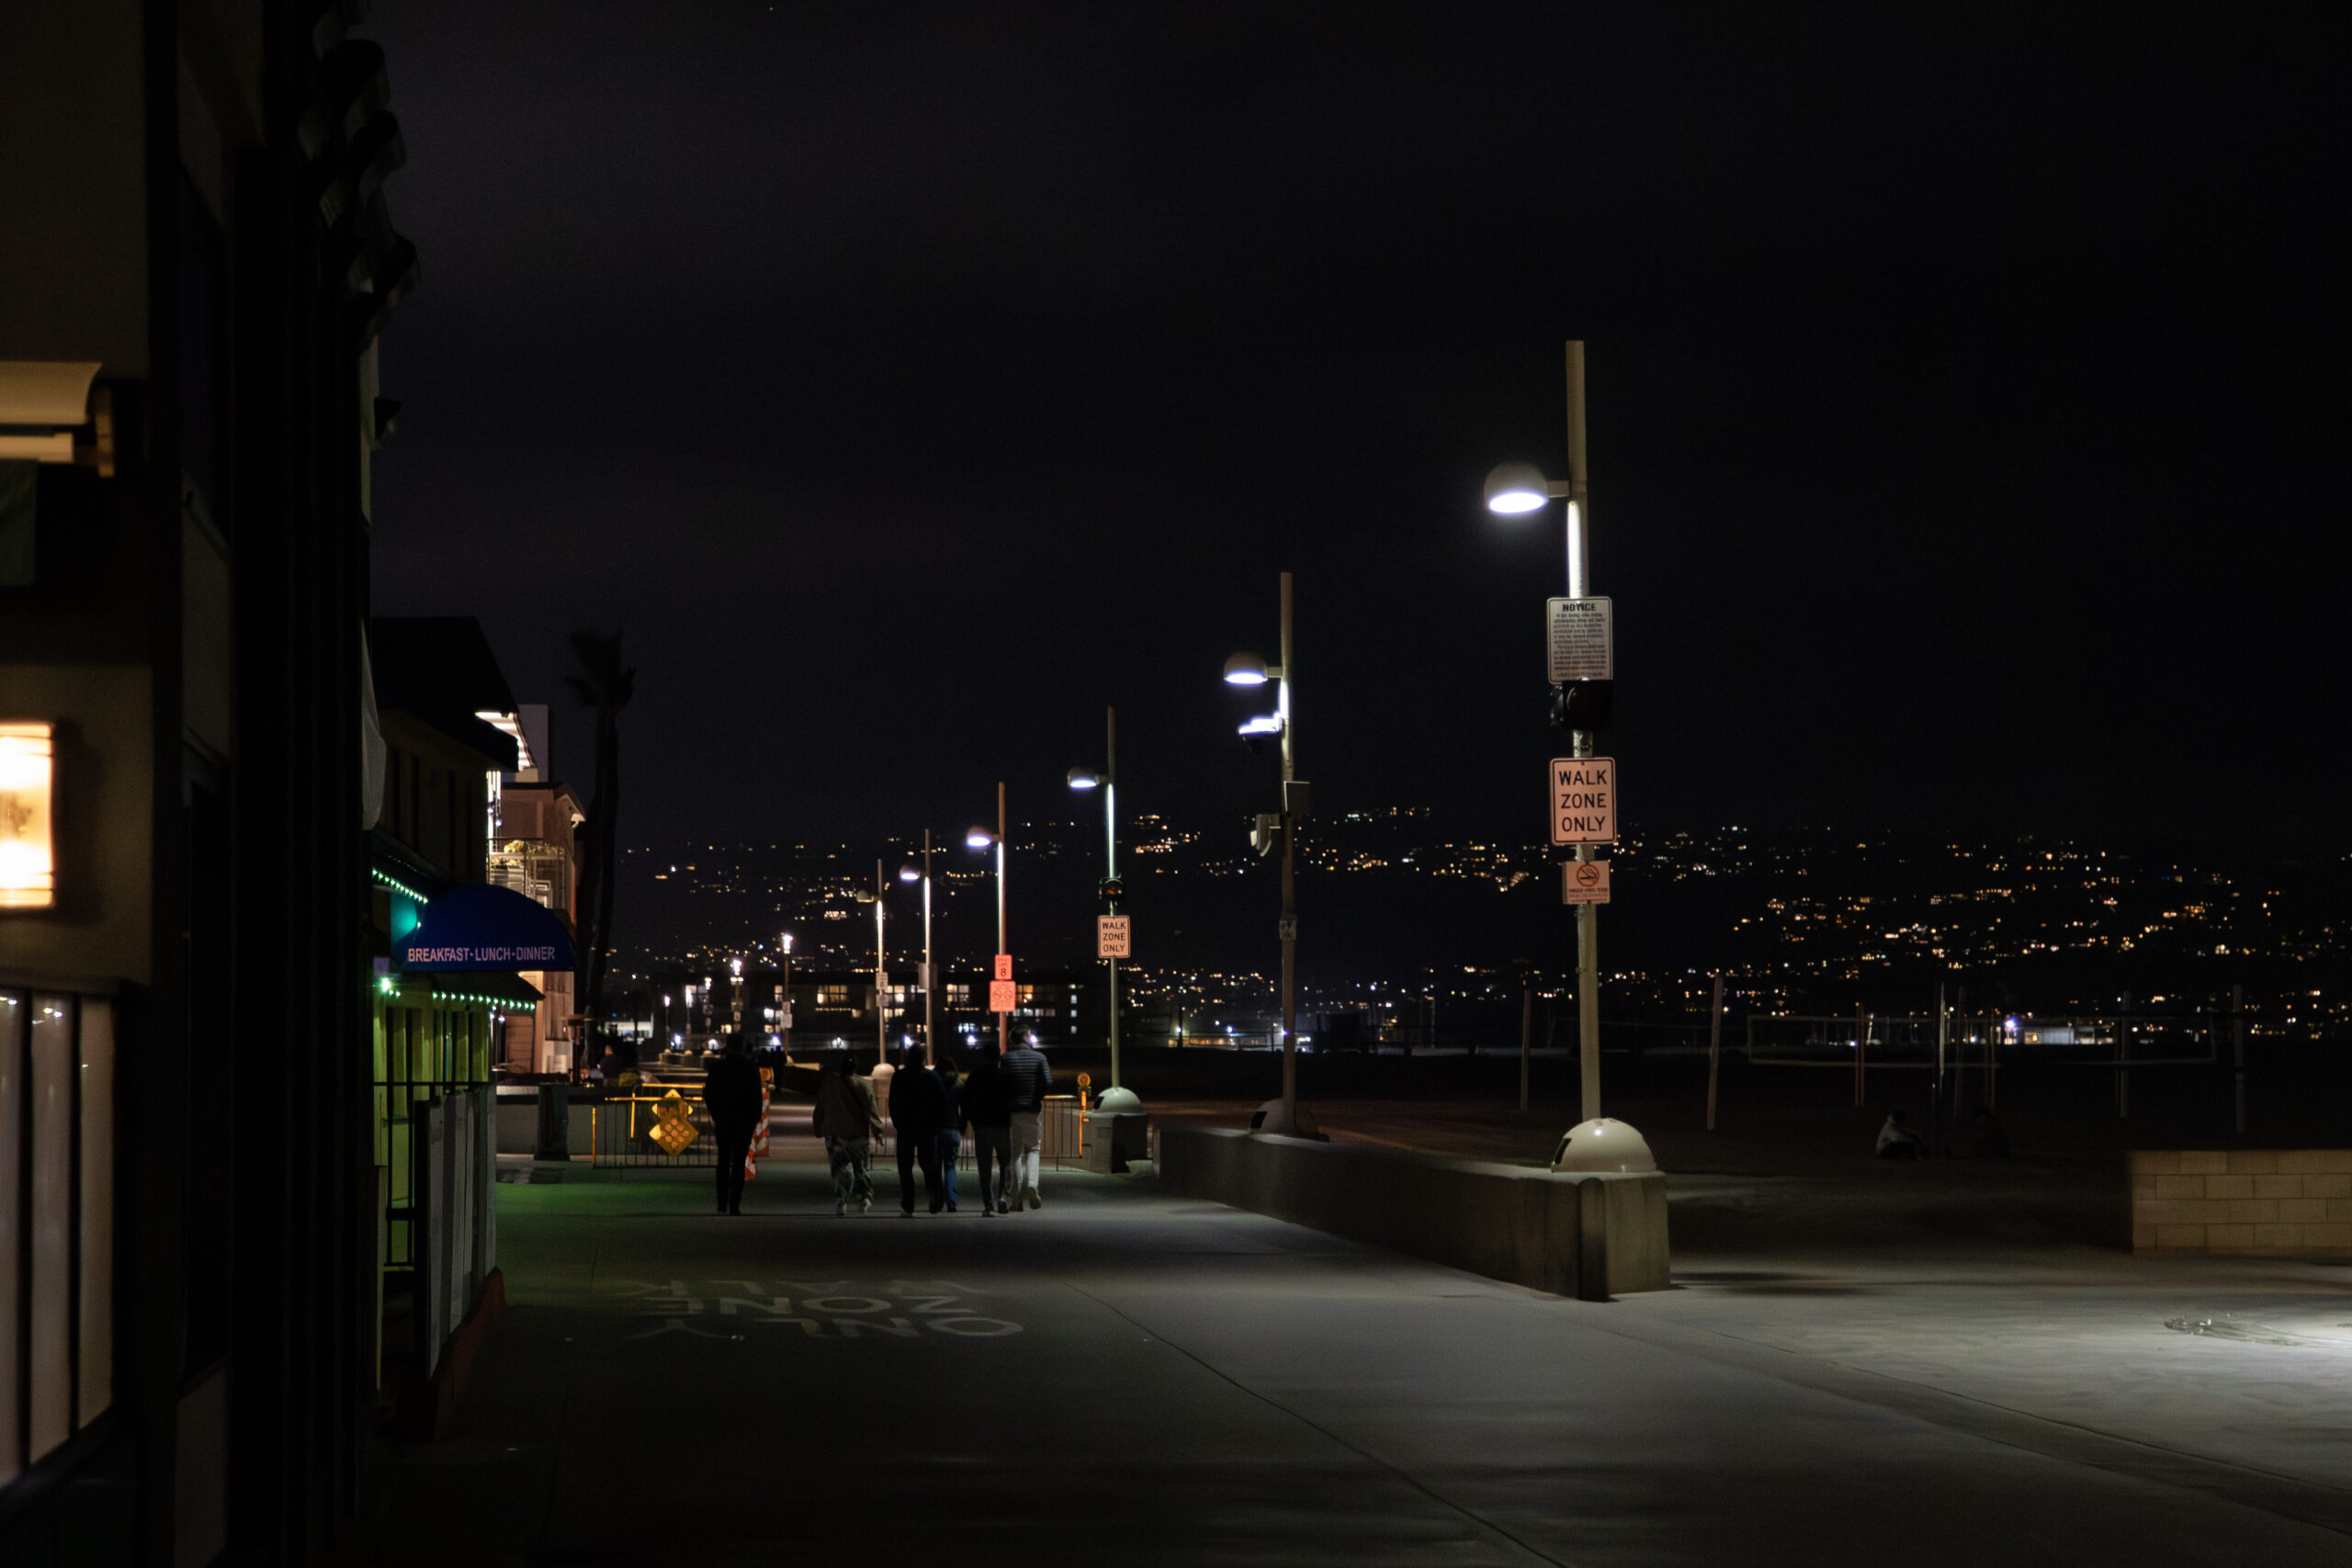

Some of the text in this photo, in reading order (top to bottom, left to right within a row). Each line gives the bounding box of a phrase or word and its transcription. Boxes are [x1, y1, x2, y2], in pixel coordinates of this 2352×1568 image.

[1563, 603, 1597, 612] NOTICE
[1559, 770, 1608, 785] WALK
[1561, 793, 1607, 809] ZONE
[1562, 816, 1606, 832] ONLY
[1102, 921, 1126, 930] WALK
[1102, 932, 1125, 942] ZONE
[1103, 943, 1125, 953] ONLY
[637, 1295, 977, 1314] ZONE
[623, 1316, 1023, 1341] ONLY
